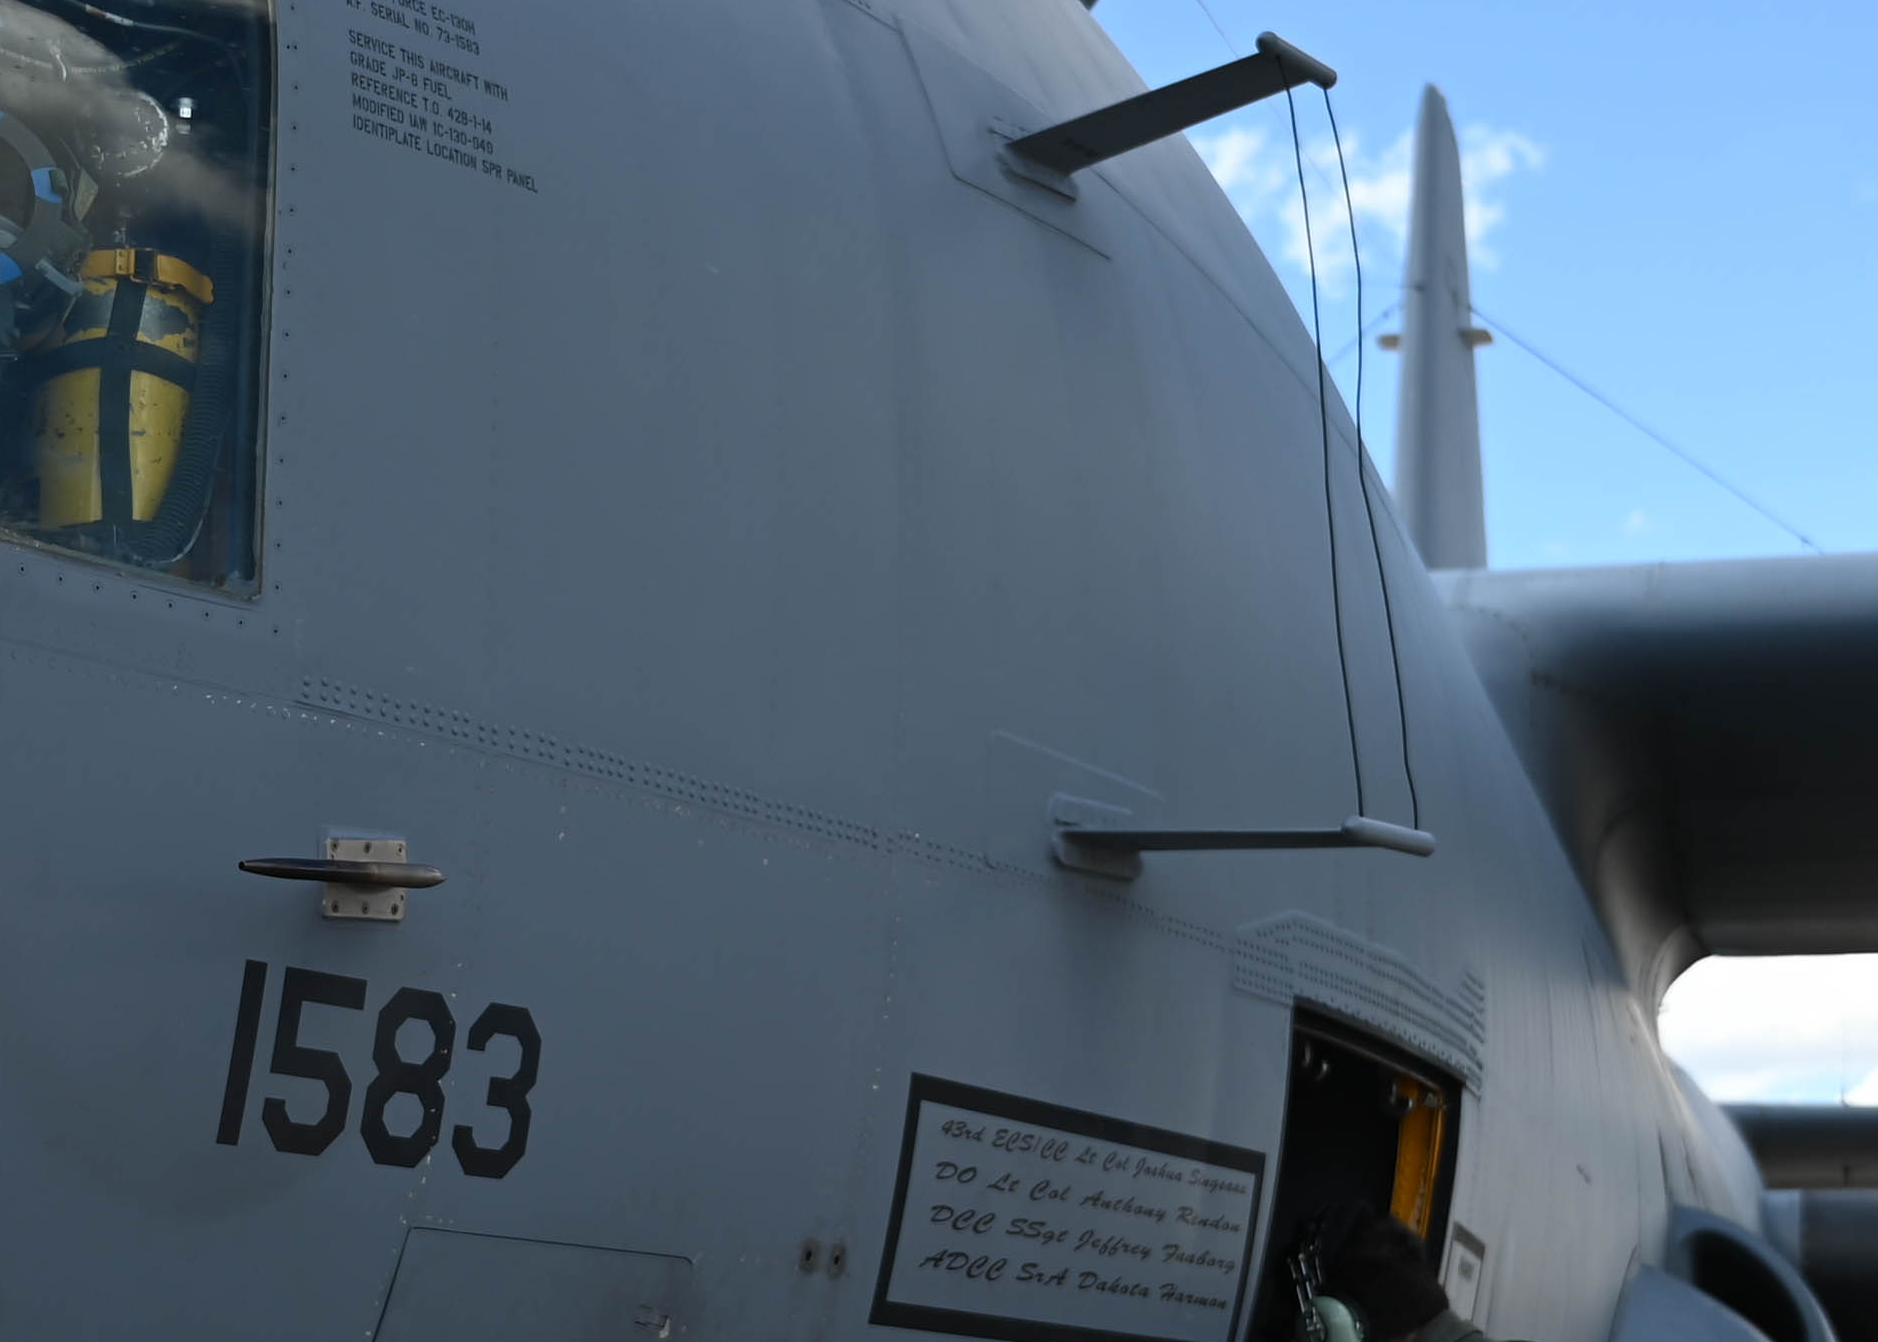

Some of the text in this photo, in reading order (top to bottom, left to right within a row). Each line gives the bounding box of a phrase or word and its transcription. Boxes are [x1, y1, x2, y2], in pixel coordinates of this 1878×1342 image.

[370, 2, 410, 29] SERIAL
[437, 27, 481, 56] 73-1583
[431, 6, 476, 36] EC-130H
[348, 29, 509, 102] SERVICE THIS AIRCRAFT WITH
[350, 50, 452, 101] GRADE JP-8 FUEL
[351, 72, 418, 109] REFERENCE
[352, 93, 404, 125] MODIFIED
[409, 112, 428, 132] IAW
[352, 114, 539, 194] IDENTIPLATE LOCATION SPR PANEL
[216, 959, 542, 1179] 1583
[941, 1119, 986, 1142] 43rd
[1074, 1146, 1098, 1164] Lt
[1102, 1151, 1127, 1172] Col
[1132, 1157, 1183, 1182] Joshua
[935, 1161, 978, 1184] DO
[986, 1172, 1020, 1192] Lt
[1029, 1179, 1072, 1202] Col
[1079, 1190, 1167, 1224] Anthony
[930, 1204, 997, 1235] DCC
[1005, 1218, 1069, 1246] SSgt
[1073, 1228, 1154, 1260] Jeffrey
[918, 1248, 1228, 1310] ADCC SrA Dakota Harmon
